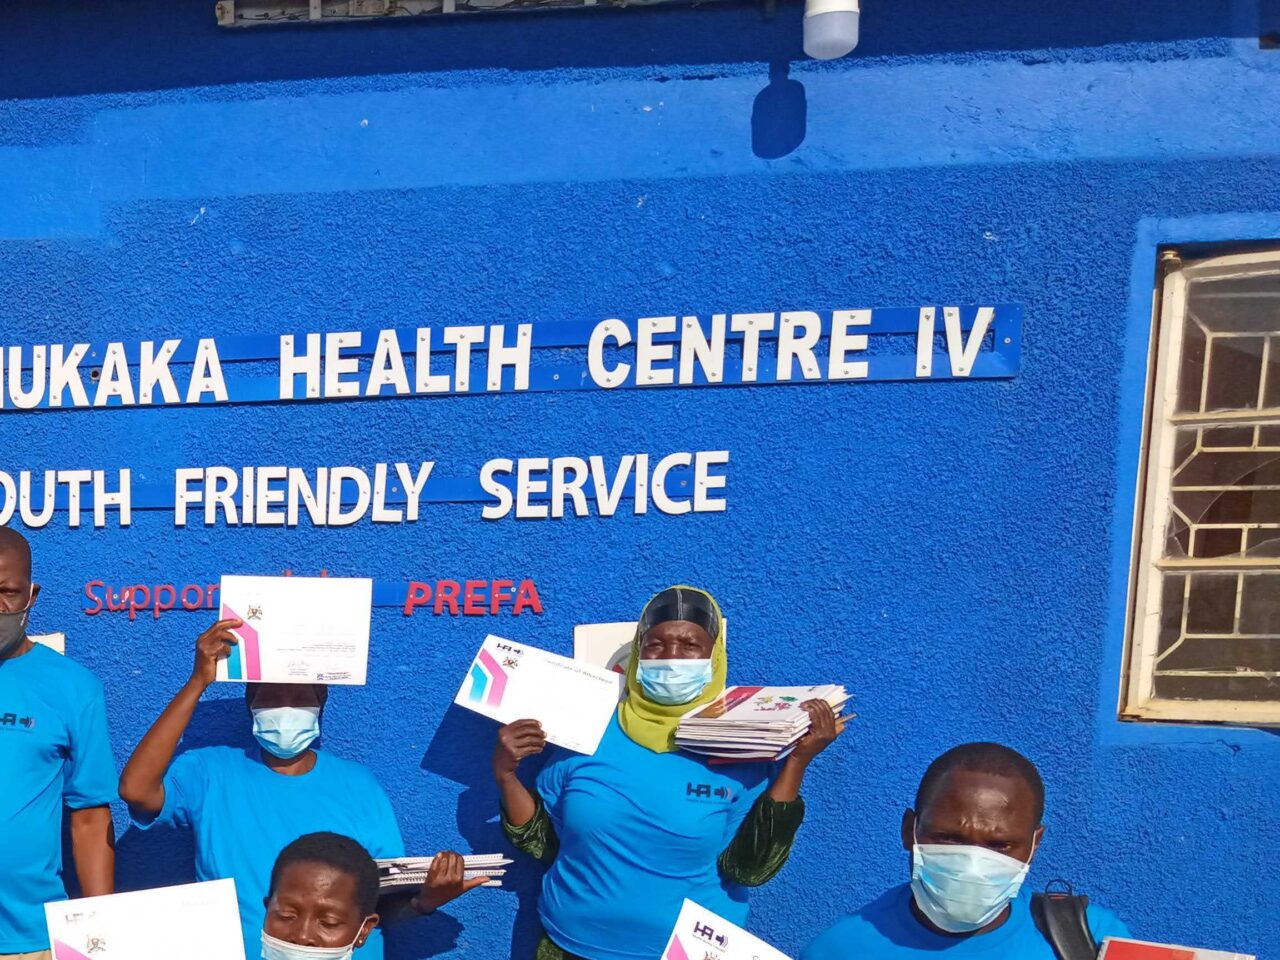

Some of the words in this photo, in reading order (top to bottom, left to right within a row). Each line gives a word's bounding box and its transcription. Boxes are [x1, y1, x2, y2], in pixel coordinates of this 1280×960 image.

[280, 323, 532, 398] HEALTH
[588, 309, 872, 389] CENTRE
[915, 306, 995, 377] IV
[175, 461, 434, 526] FRIENDLY
[479, 450, 729, 519] SERVICE
[85, 579, 222, 619] Suppor
[404, 578, 544, 616] PREFA
